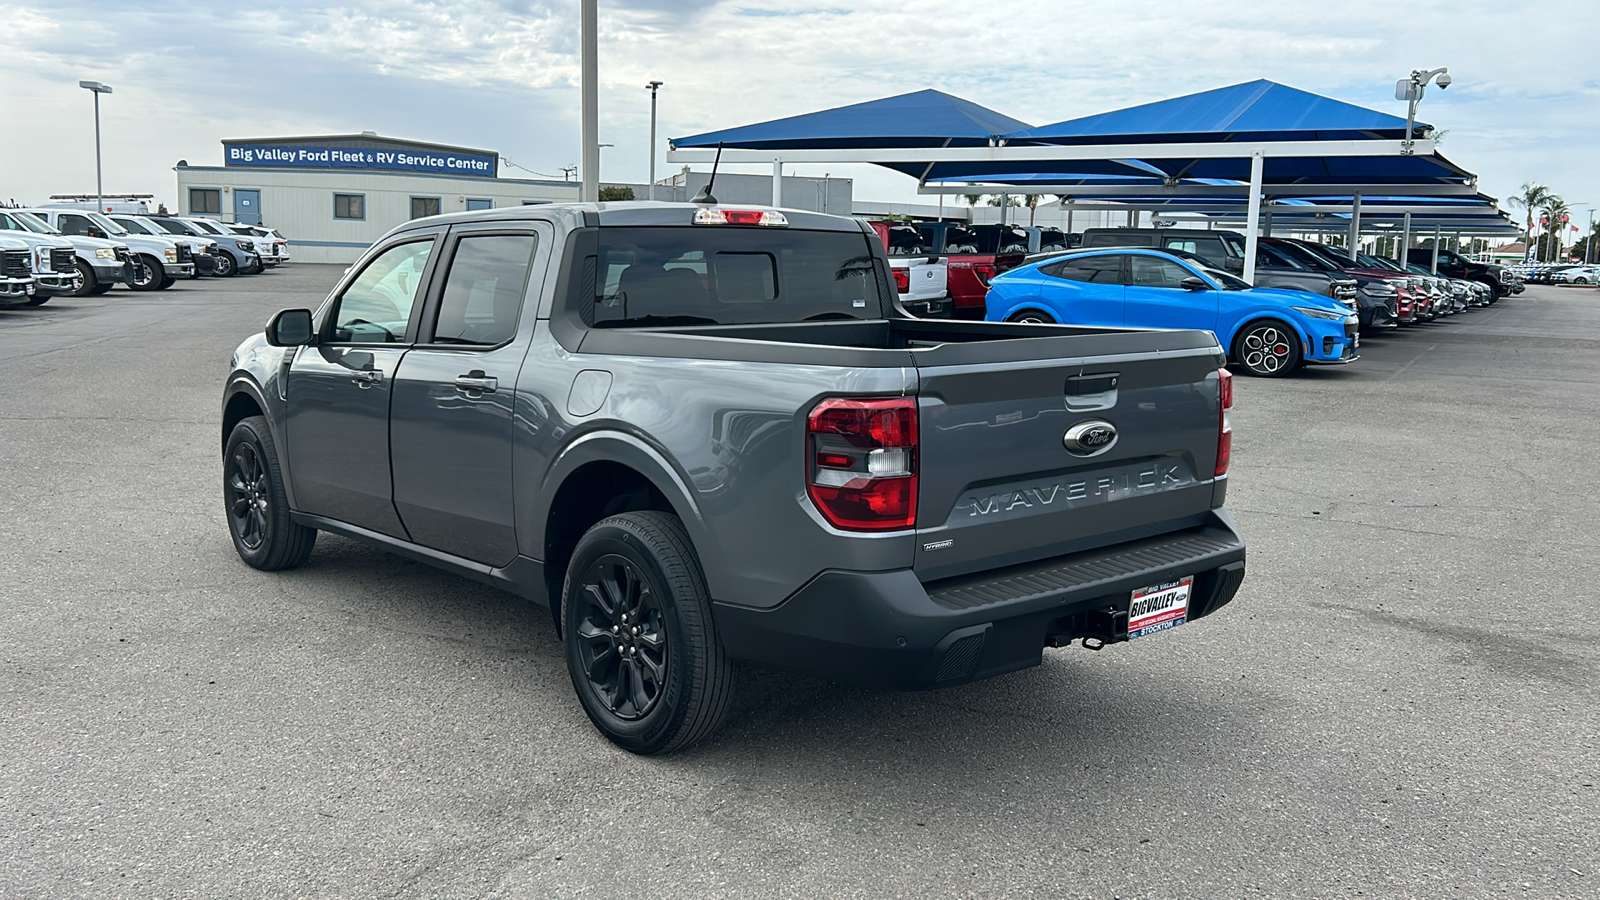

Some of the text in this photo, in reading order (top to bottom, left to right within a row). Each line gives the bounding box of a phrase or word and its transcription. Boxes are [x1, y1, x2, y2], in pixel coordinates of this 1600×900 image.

[230, 148, 489, 170] Big Valley Ford Fleet & RV Service Center
[1087, 429, 1110, 445] Ford
[969, 465, 1180, 516] MAVERICK
[1160, 581, 1179, 590] VALLEY
[1141, 620, 1174, 635] STOCKTON
